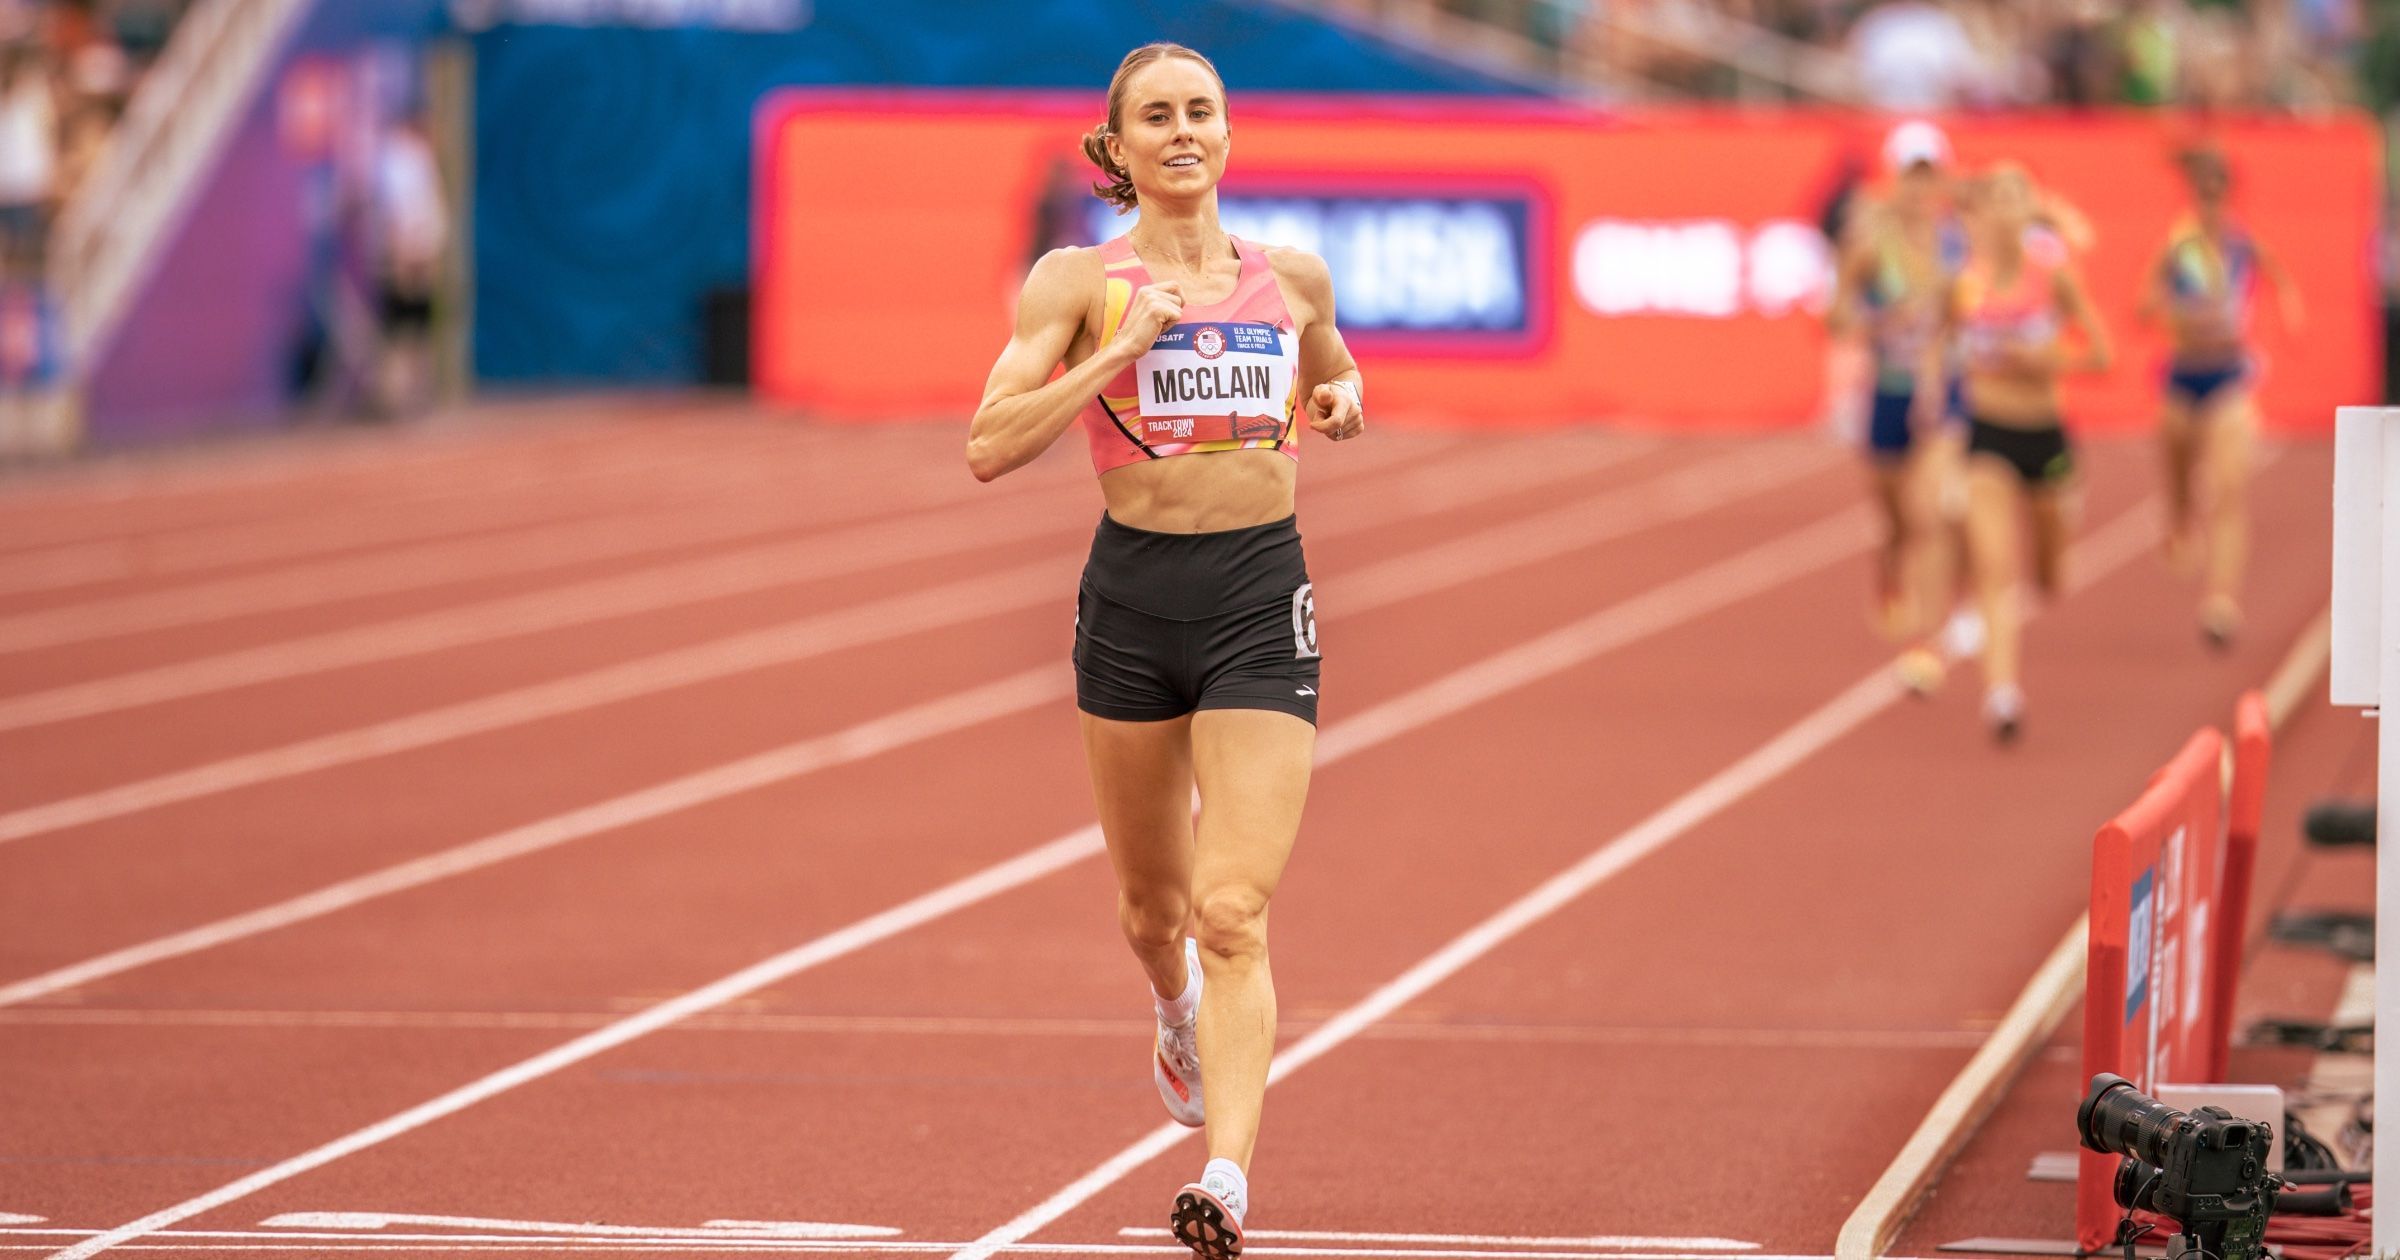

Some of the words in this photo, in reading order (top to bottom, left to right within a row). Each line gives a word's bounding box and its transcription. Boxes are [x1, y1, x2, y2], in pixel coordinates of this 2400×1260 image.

[1234, 327, 1246, 335] U.S.
[1246, 328, 1271, 336] OLYMPIC
[1155, 333, 1184, 343] USATF
[1235, 335, 1251, 343] TEAM
[1252, 336, 1273, 344] TRIALS
[1152, 366, 1270, 403] MCCLAIN
[1148, 418, 1195, 432] TRACKTOWN
[1173, 428, 1193, 438] 2024
[1301, 588, 1318, 654] 6
